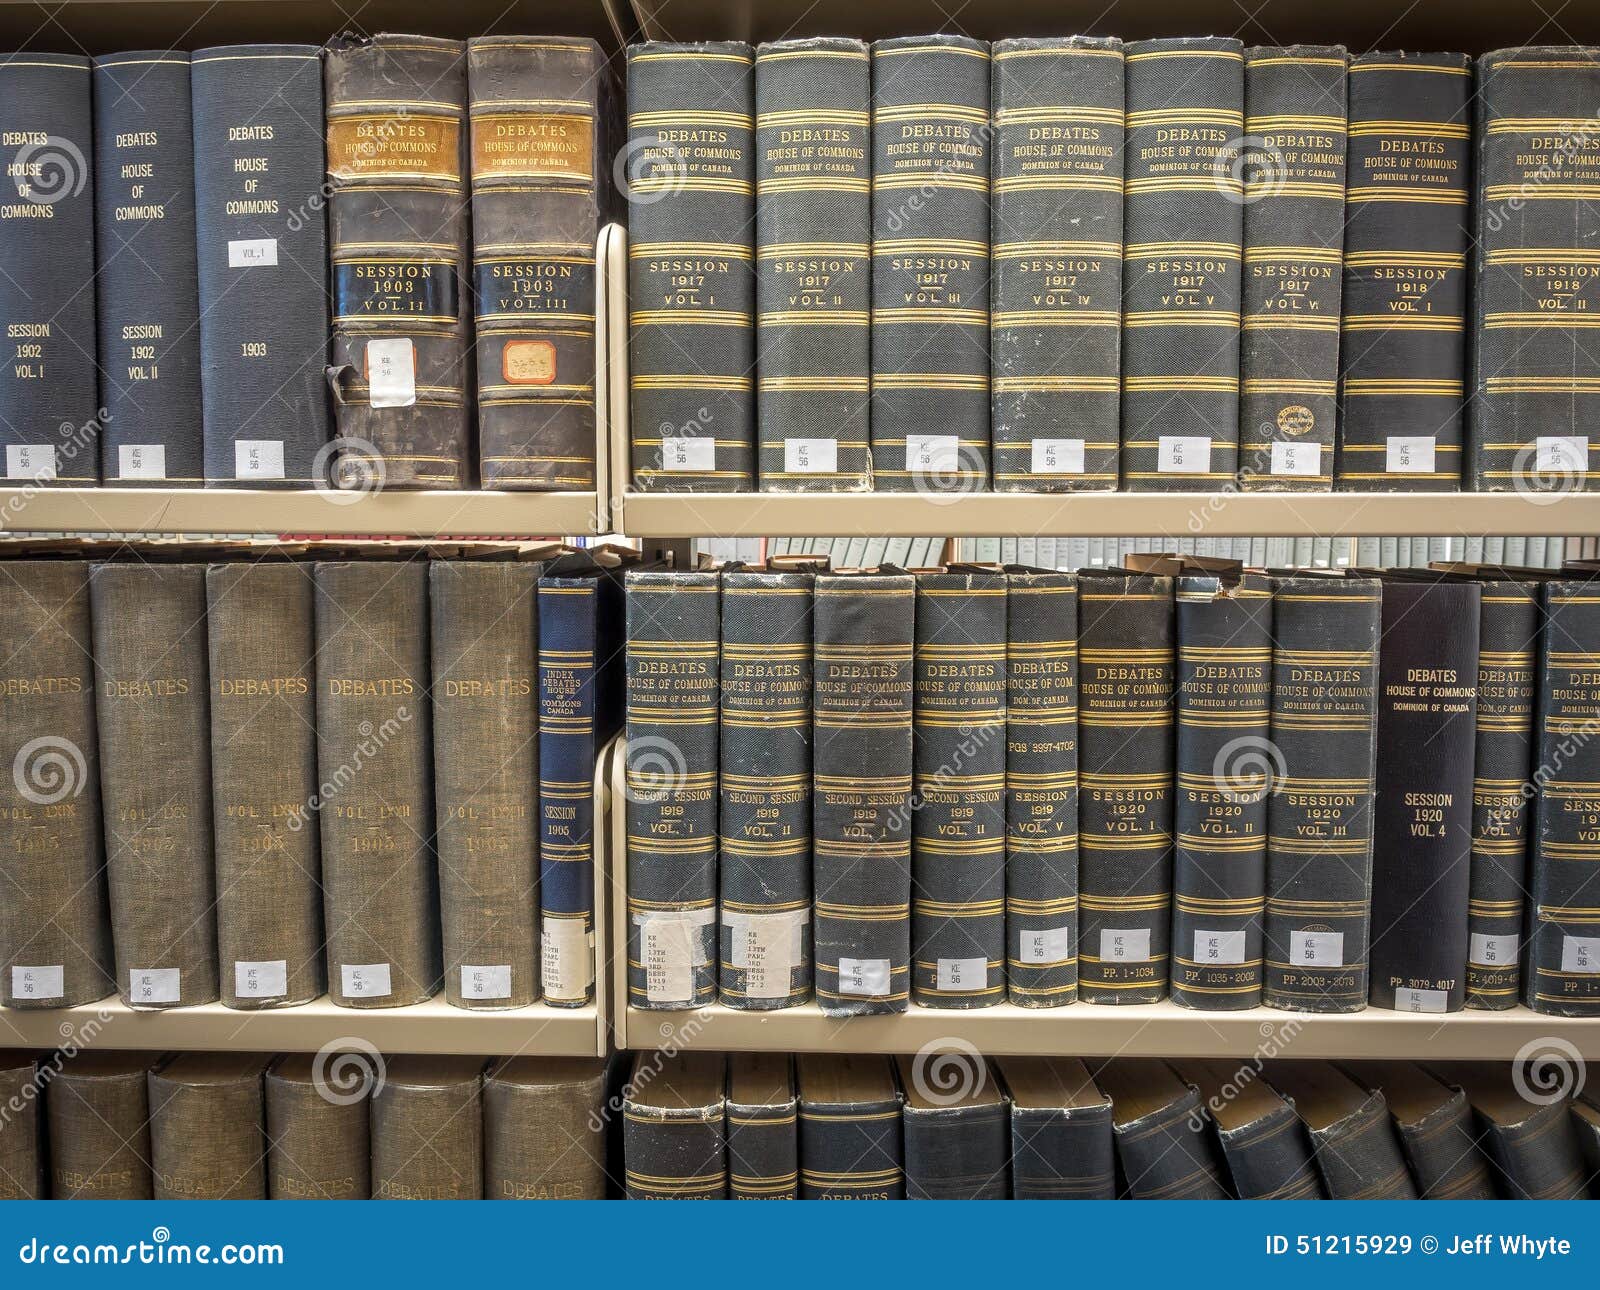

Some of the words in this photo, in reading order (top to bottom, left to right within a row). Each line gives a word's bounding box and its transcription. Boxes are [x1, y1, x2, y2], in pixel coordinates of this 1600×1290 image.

[229, 126, 273, 140] DEBATES
[357, 126, 425, 137] DEBATES
[497, 126, 566, 136] DEBATES
[658, 131, 727, 142] DEBATES
[781, 130, 850, 143] DEBATES
[902, 125, 970, 138] DEBATES
[1030, 128, 1099, 139] DEBATES
[1157, 130, 1227, 141] DEBATES
[3, 132, 48, 146] DEBATES
[116, 132, 157, 147] DEBATES
[1264, 136, 1333, 147] DEBATES
[346, 143, 374, 153] HOUSE
[376, 142, 388, 152] OF
[390, 142, 437, 153] COMMONS
[1381, 141, 1444, 153] DEBATES
[644, 149, 673, 159] HOUSE
[679, 149, 690, 158] OF
[694, 149, 741, 160] COMMONS
[767, 149, 798, 159] HOUSE
[801, 148, 812, 157] OF
[817, 147, 864, 158] COMMONS
[1248, 154, 1281, 164] HOUSE
[1286, 153, 1297, 162] OF
[1302, 153, 1344, 165] COMMONS
[1365, 158, 1396, 167] HOUSE
[1401, 158, 1412, 167] OF
[1415, 159, 1457, 169] COMMONS
[1516, 156, 1548, 165] HOUSE
[8, 162, 42, 176] HOUSE
[234, 158, 268, 172] HOUSE
[121, 164, 153, 178] HOUSE
[1422, 175, 1448, 183] CANADA
[18, 184, 32, 196] OF
[245, 180, 258, 192] OF
[132, 186, 144, 198] OF
[1, 204, 53, 218] COMMONS
[116, 205, 164, 220] COMMONS
[226, 200, 278, 214] COMMONS
[650, 262, 728, 272] SESSION
[775, 262, 853, 272] SESSION
[892, 260, 971, 270] SESSION
[1020, 262, 1100, 272] SESSION
[1147, 262, 1226, 272] SESSION
[357, 266, 432, 278] SESSION
[493, 266, 572, 277] SESSION
[1254, 267, 1331, 277] SESSION
[1374, 270, 1446, 280] SESSION
[672, 277, 705, 285] 1917
[800, 277, 830, 286] 1917
[917, 274, 948, 283] 1917
[1045, 277, 1077, 286] 1917
[1173, 277, 1204, 285] 1917
[374, 282, 413, 292] 1903
[512, 281, 552, 292] 1903
[1280, 281, 1310, 290] 1917
[1396, 283, 1427, 292] 1918
[1547, 281, 1580, 290] 1918
[364, 300, 404, 310] VOL.
[501, 299, 540, 308] VOL.
[8, 324, 49, 337] SESSION
[122, 325, 162, 338] SESSION
[16, 345, 41, 358] 1902
[131, 346, 154, 359] 1902
[242, 343, 266, 356] 1903
[1046, 457, 1056, 467] 56
[1173, 455, 1183, 465] 56
[639, 662, 706, 673] DEBATES
[734, 665, 800, 676] DEBATES
[830, 665, 898, 677] DEBATES
[927, 666, 994, 676] DEBATES
[1014, 662, 1068, 674] DEBATES
[1196, 667, 1262, 678] DEBATES
[1097, 668, 1163, 680] DEBATES
[1292, 670, 1360, 682] DEBATES
[1408, 670, 1456, 683] DEBATES
[106, 678, 188, 697] DEBATES
[220, 678, 307, 695] DEBATES
[330, 679, 413, 695] DEBATES
[446, 679, 530, 696] DEBATES
[543, 679, 580, 687] DEBATES
[1387, 687, 1415, 696] HOUSE
[1419, 687, 1430, 696] OF
[1433, 688, 1475, 697] COMMONS
[1552, 690, 1587, 700] HOUSE
[1394, 703, 1428, 711] DOMINION
[1444, 704, 1469, 712] CANADA
[1009, 743, 1027, 752] PGS
[730, 793, 765, 803] SECOND
[826, 795, 862, 805] SECOND
[1016, 791, 1068, 801] SESSION
[1093, 790, 1164, 801] SESSION
[1188, 792, 1261, 802] SESSION
[1288, 796, 1355, 806] SESSION
[1405, 793, 1452, 806] SESSION
[544, 806, 576, 819] SESSION
[661, 806, 684, 815] 1919
[757, 809, 779, 818] 1919
[854, 810, 877, 819] 1919
[951, 808, 974, 817] 1919
[1031, 805, 1053, 814] 1919
[1113, 804, 1145, 814] 1920
[1209, 806, 1242, 816] 1920
[1307, 809, 1341, 818] 1920
[1415, 810, 1442, 821] 1920
[548, 825, 569, 836] 1905
[1106, 822, 1143, 832] VOL.
[1297, 826, 1327, 835] VOL.
[1411, 824, 1434, 836] VOL.
[1439, 825, 1445, 836] 4
[1486, 952, 1495, 961] 56
